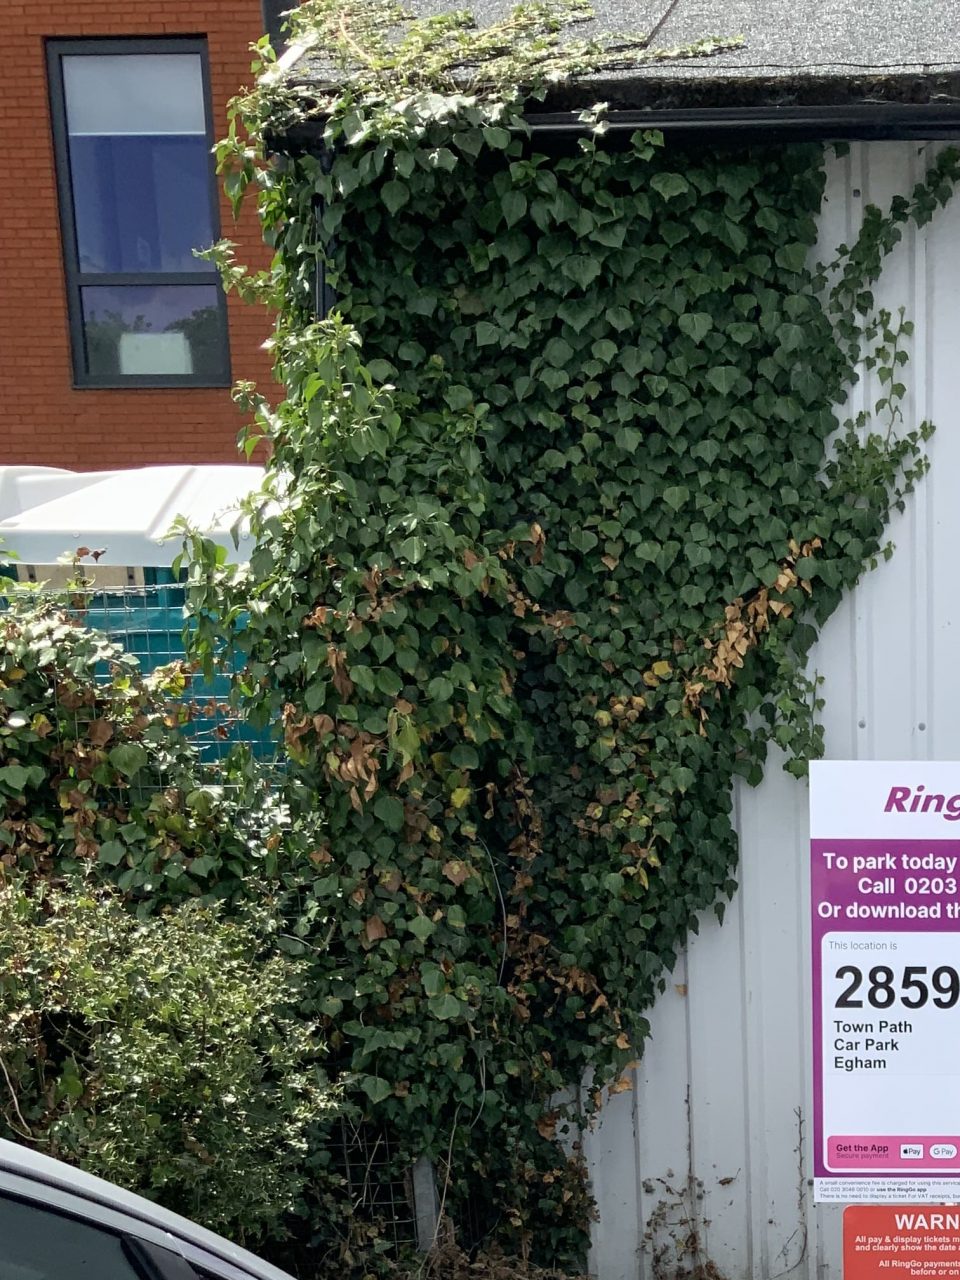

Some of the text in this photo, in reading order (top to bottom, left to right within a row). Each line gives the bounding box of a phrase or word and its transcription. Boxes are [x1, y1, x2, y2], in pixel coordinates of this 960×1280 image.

[822, 853, 849, 870] To
[852, 853, 897, 873] park
[900, 853, 958, 873] today
[857, 877, 895, 894] Call
[904, 877, 958, 894] 0203
[817, 901, 842, 919] Or
[845, 901, 941, 919] download
[828, 940, 898, 950] This location is
[834, 965, 960, 1009] 2859
[832, 1020, 913, 1033] Town Path
[833, 1038, 900, 1051] Car Park
[833, 1057, 888, 1072] Egham
[836, 1144, 889, 1154] Get the App
[941, 1148, 954, 1156] Pay
[867, 1237, 883, 1245] pay
[892, 1236, 922, 1245] display
[871, 1244, 900, 1253] clearly
[878, 1260, 890, 1268] All
[891, 1260, 924, 1269] RingGo
